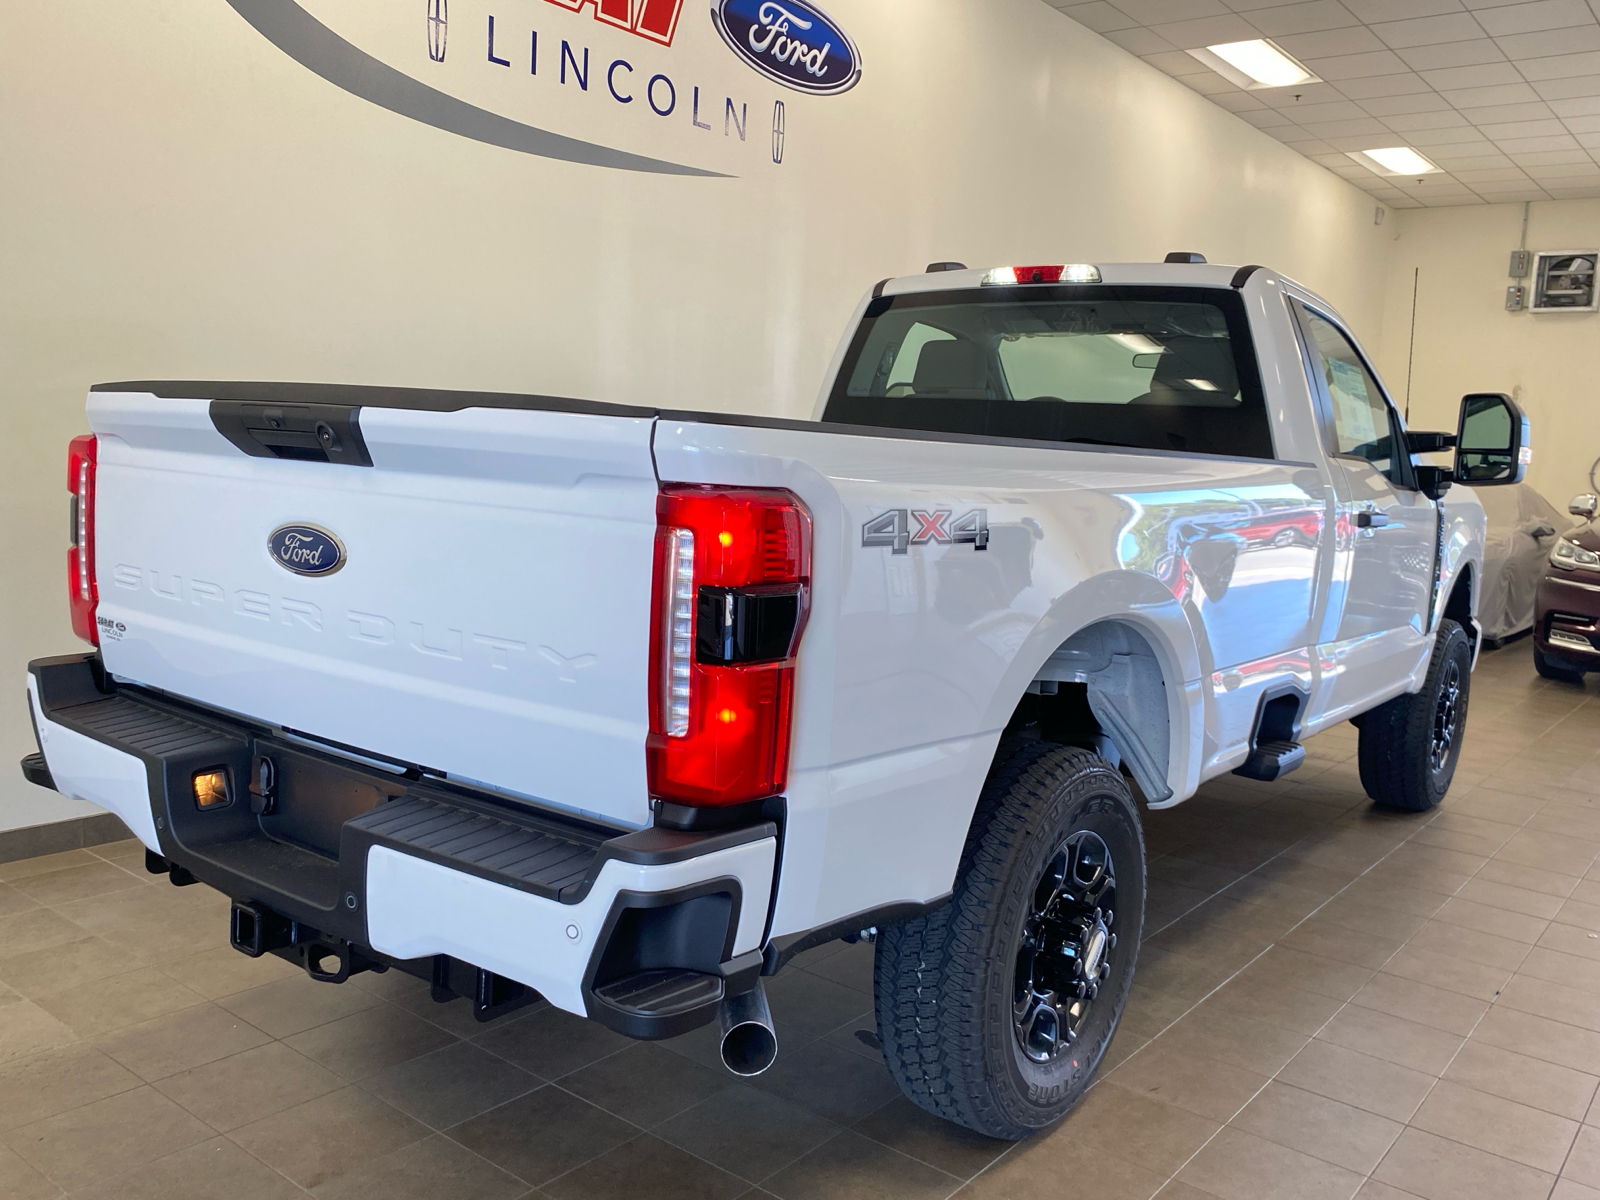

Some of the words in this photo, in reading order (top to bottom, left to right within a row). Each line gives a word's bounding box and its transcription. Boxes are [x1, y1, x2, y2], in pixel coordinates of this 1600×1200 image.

[486, 14, 748, 142] LINCOLN
[749, 1, 832, 78] Ford
[281, 532, 324, 566] Ford
[114, 563, 323, 633] SUPER
[347, 609, 598, 684] DUTY
